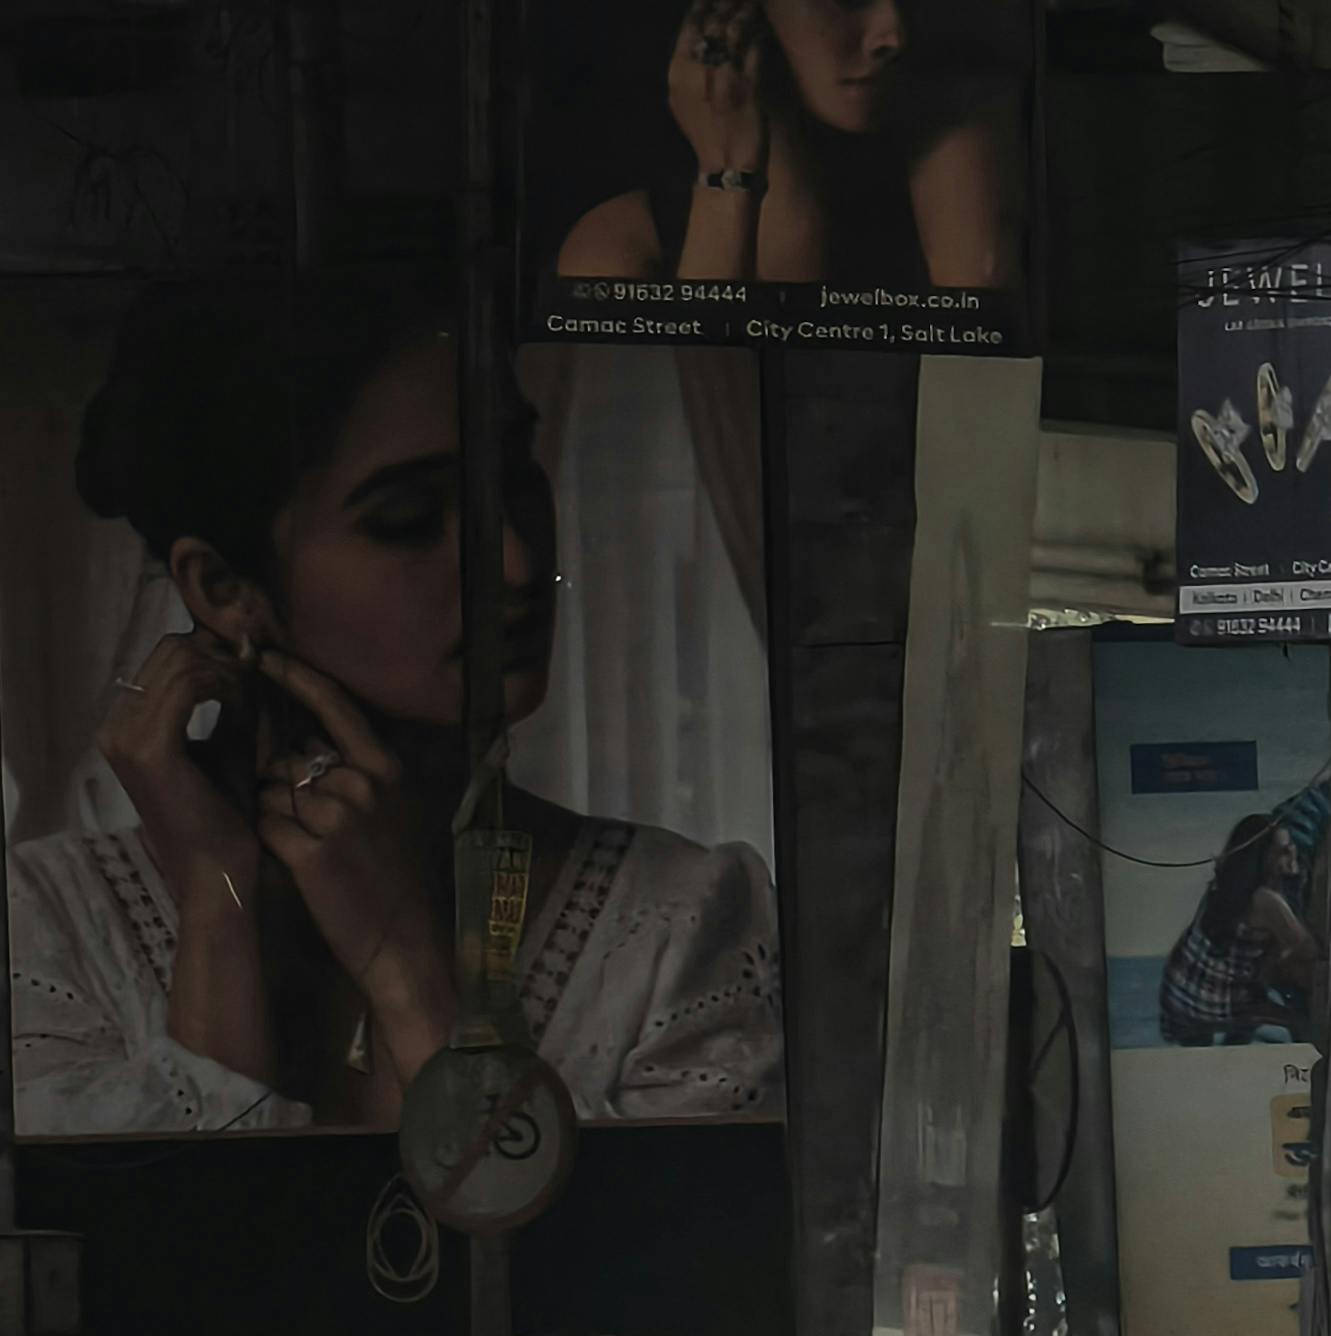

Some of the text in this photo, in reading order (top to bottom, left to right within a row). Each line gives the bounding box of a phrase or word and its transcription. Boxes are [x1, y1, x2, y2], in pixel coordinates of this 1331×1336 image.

[613, 284, 980, 311] 91632 94444 jewelbox.co.in
[546, 315, 628, 335] Camac
[633, 317, 702, 336] Street
[746, 320, 794, 342] City
[797, 322, 875, 341] Centre
[900, 326, 946, 344] Salt
[950, 327, 1004, 346] Lake
